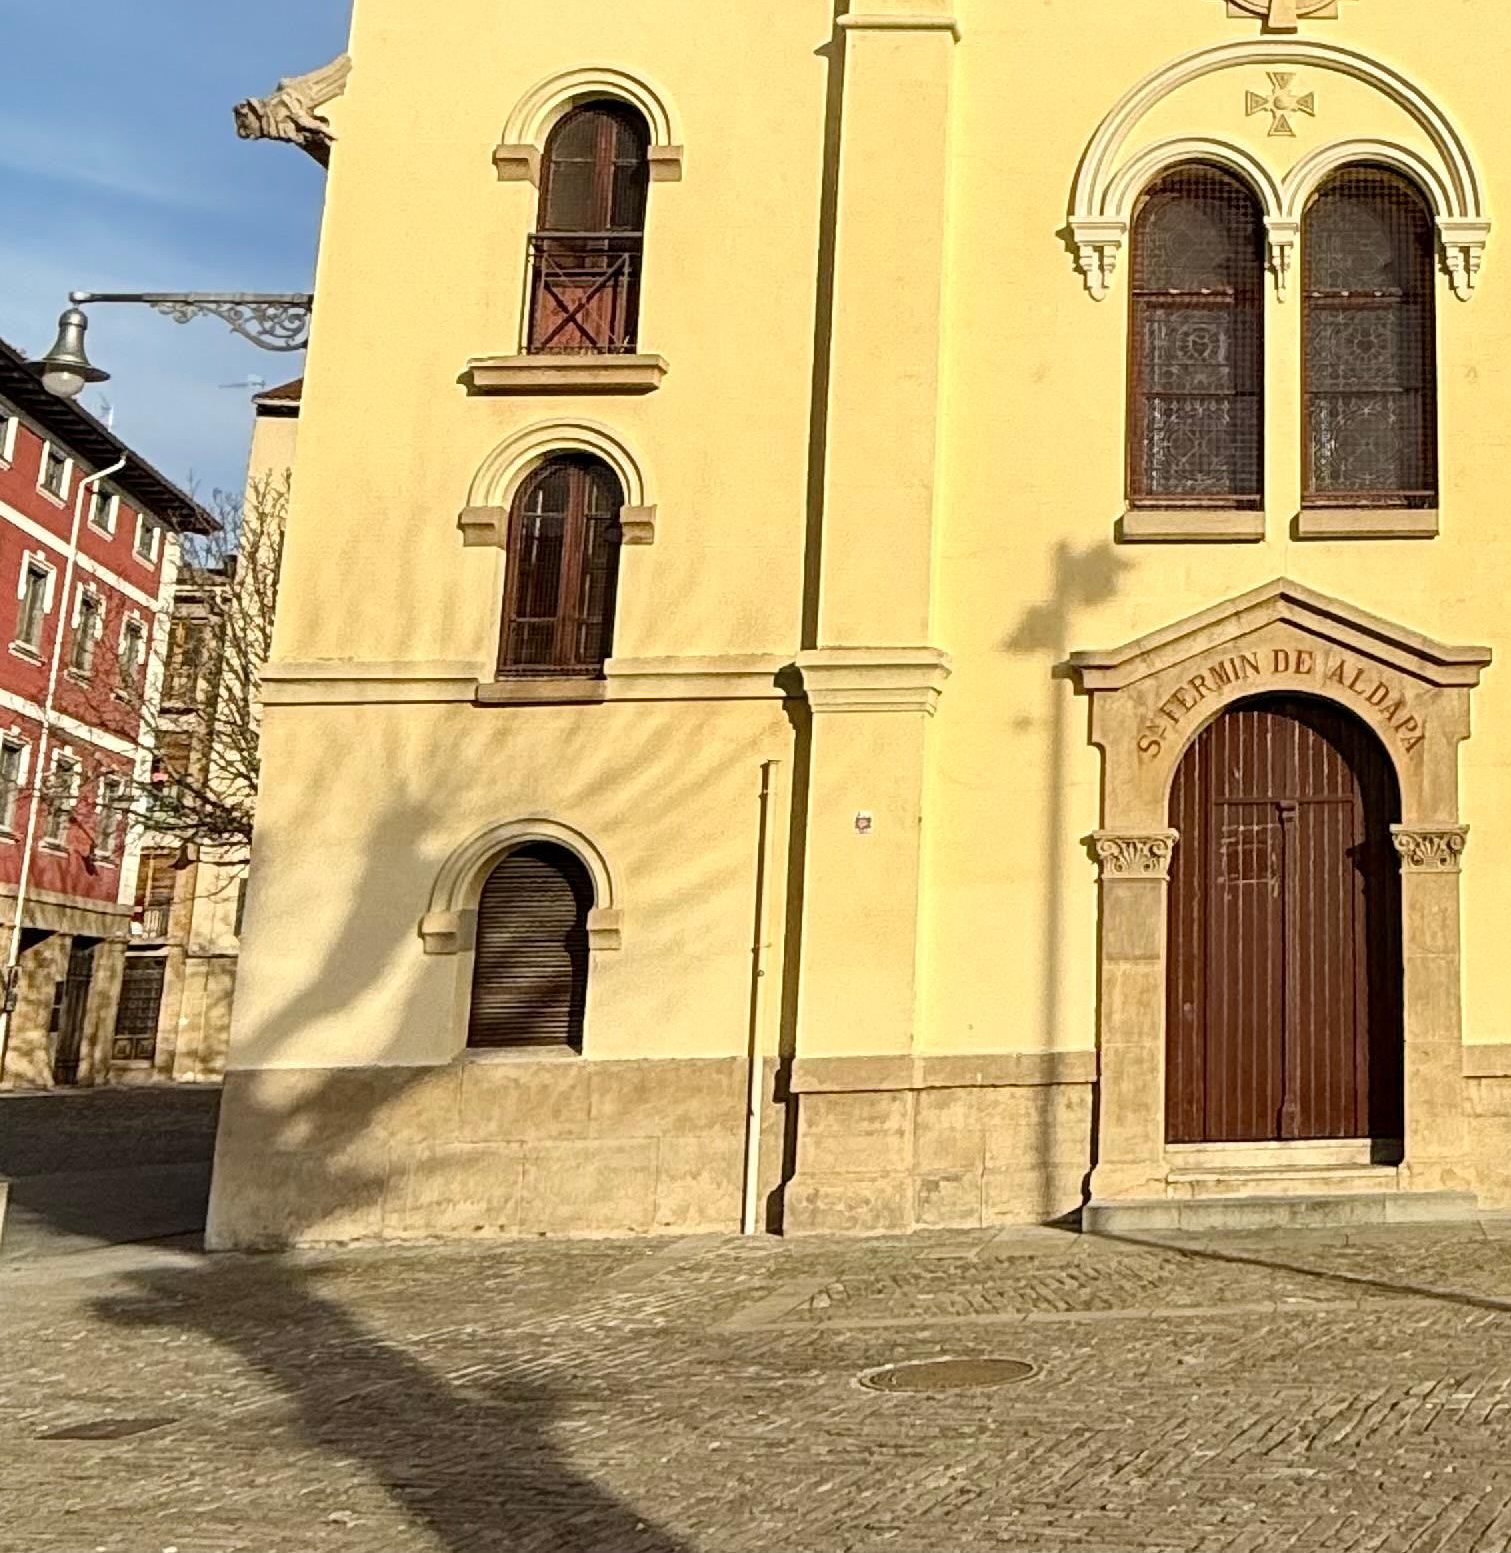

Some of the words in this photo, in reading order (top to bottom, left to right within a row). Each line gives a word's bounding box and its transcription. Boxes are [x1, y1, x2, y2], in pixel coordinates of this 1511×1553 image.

[1160, 652, 1261, 724] FERMIN
[1272, 648, 1313, 675] DE
[1326, 659, 1425, 753] ALDAPA
